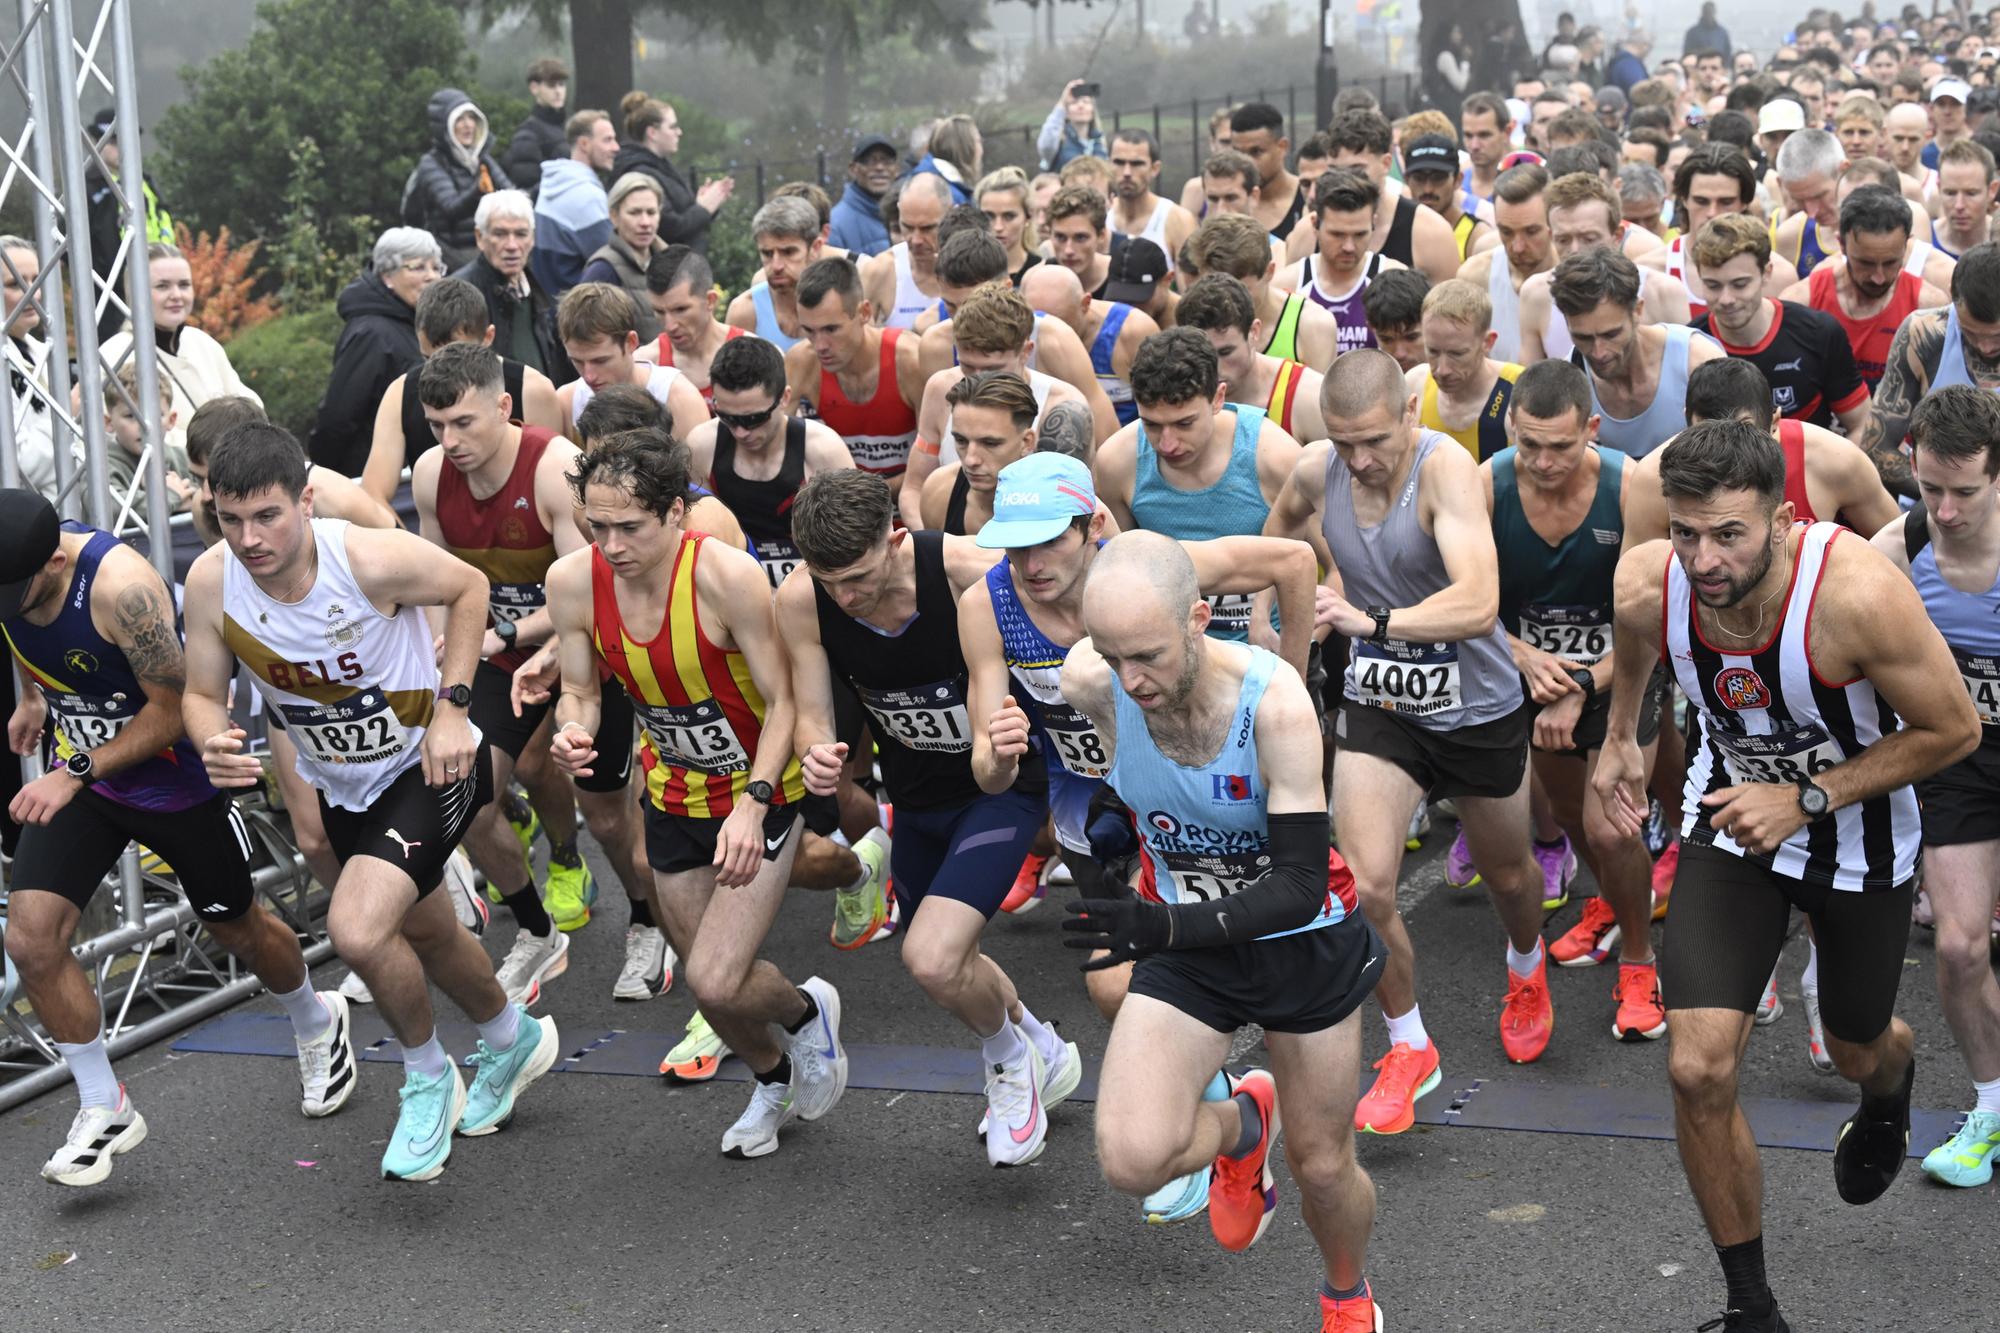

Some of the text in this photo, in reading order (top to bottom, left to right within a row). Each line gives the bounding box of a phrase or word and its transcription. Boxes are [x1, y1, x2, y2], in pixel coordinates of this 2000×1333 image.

[1001, 492, 1041, 506] HOKA
[1525, 622, 1606, 656] 5526
[265, 651, 365, 690] BELS
[1360, 662, 1453, 701] 4002
[1365, 698, 1382, 708] UP
[1395, 699, 1453, 714] RUNNING
[303, 716, 397, 752] 1822
[645, 720, 731, 756] 5713
[1237, 706, 1253, 750] soar
[345, 743, 403, 764] RUNNING
[914, 741, 973, 752] RUNNING
[717, 760, 747, 776] 5713
[1070, 762, 1087, 773] UP
[1184, 823, 1271, 848] ROYAL
